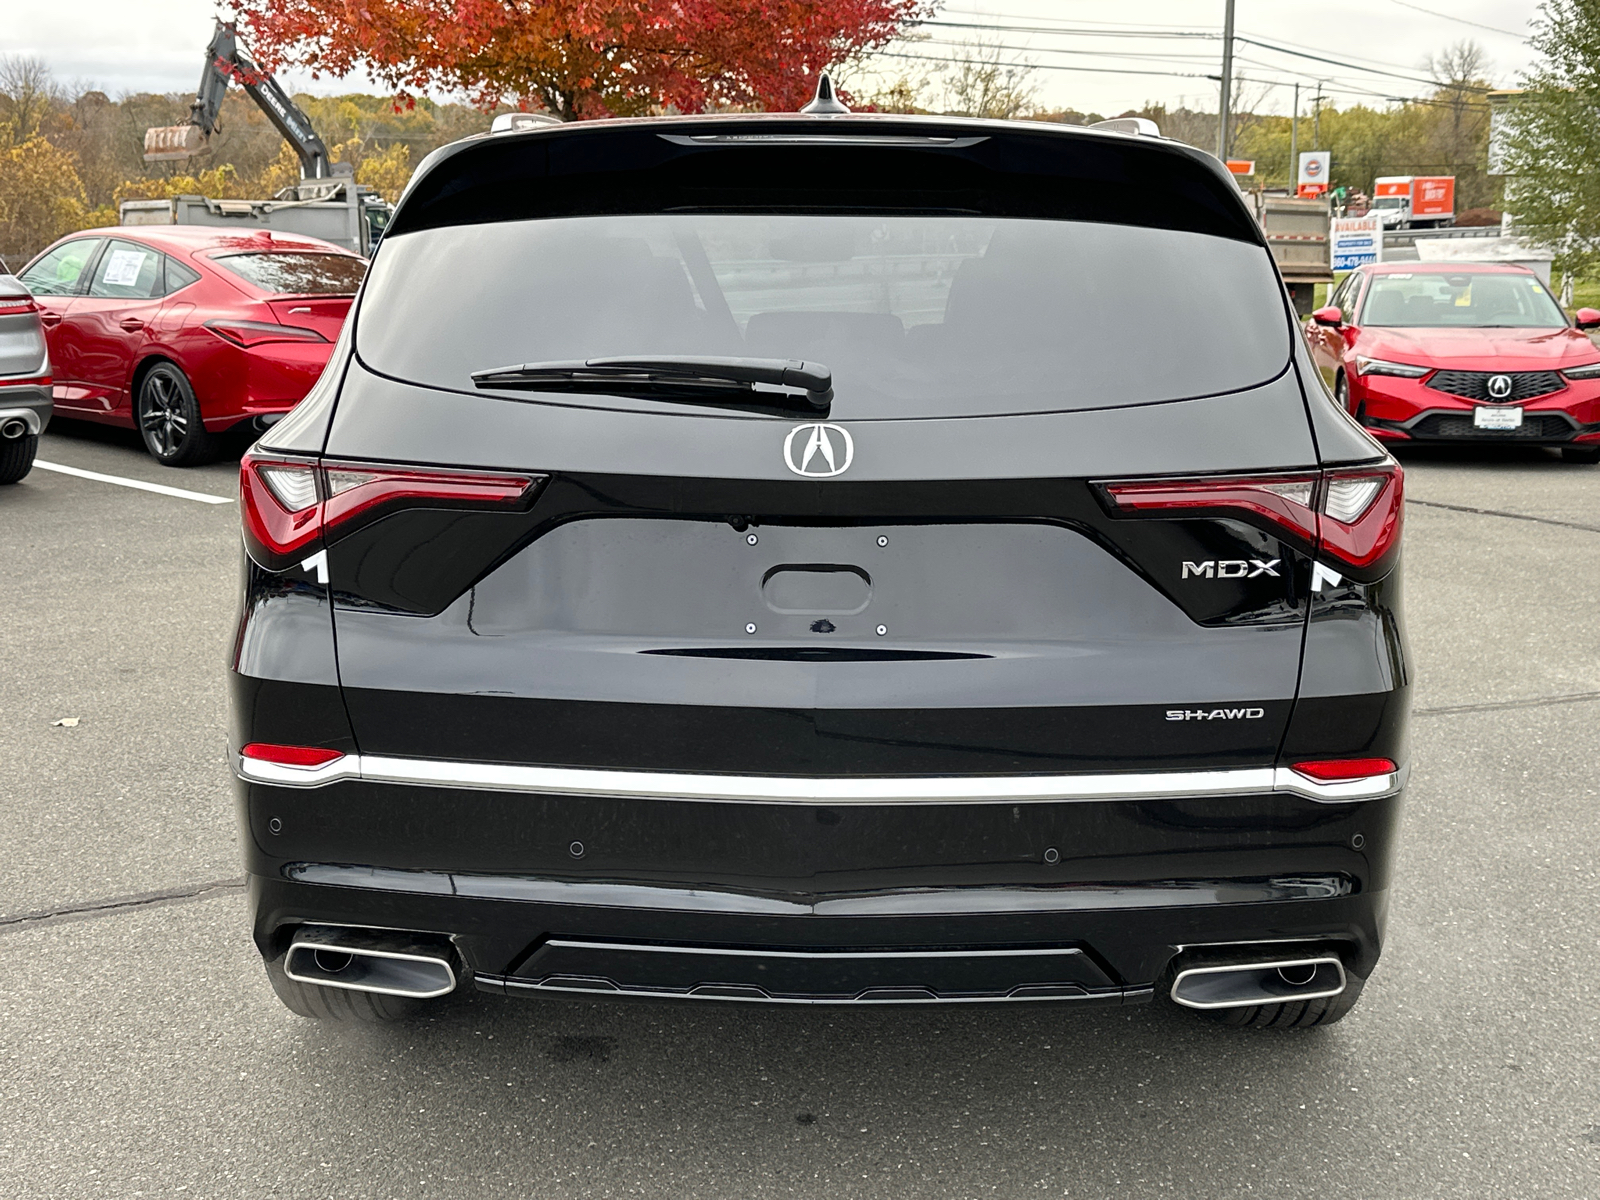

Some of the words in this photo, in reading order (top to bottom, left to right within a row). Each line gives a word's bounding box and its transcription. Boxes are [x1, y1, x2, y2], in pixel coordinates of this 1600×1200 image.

[260, 84, 287, 118] DEERE
[1335, 219, 1377, 232] AVAILABLE
[1181, 559, 1281, 579] MDX
[1165, 708, 1265, 721] SH-AWD
